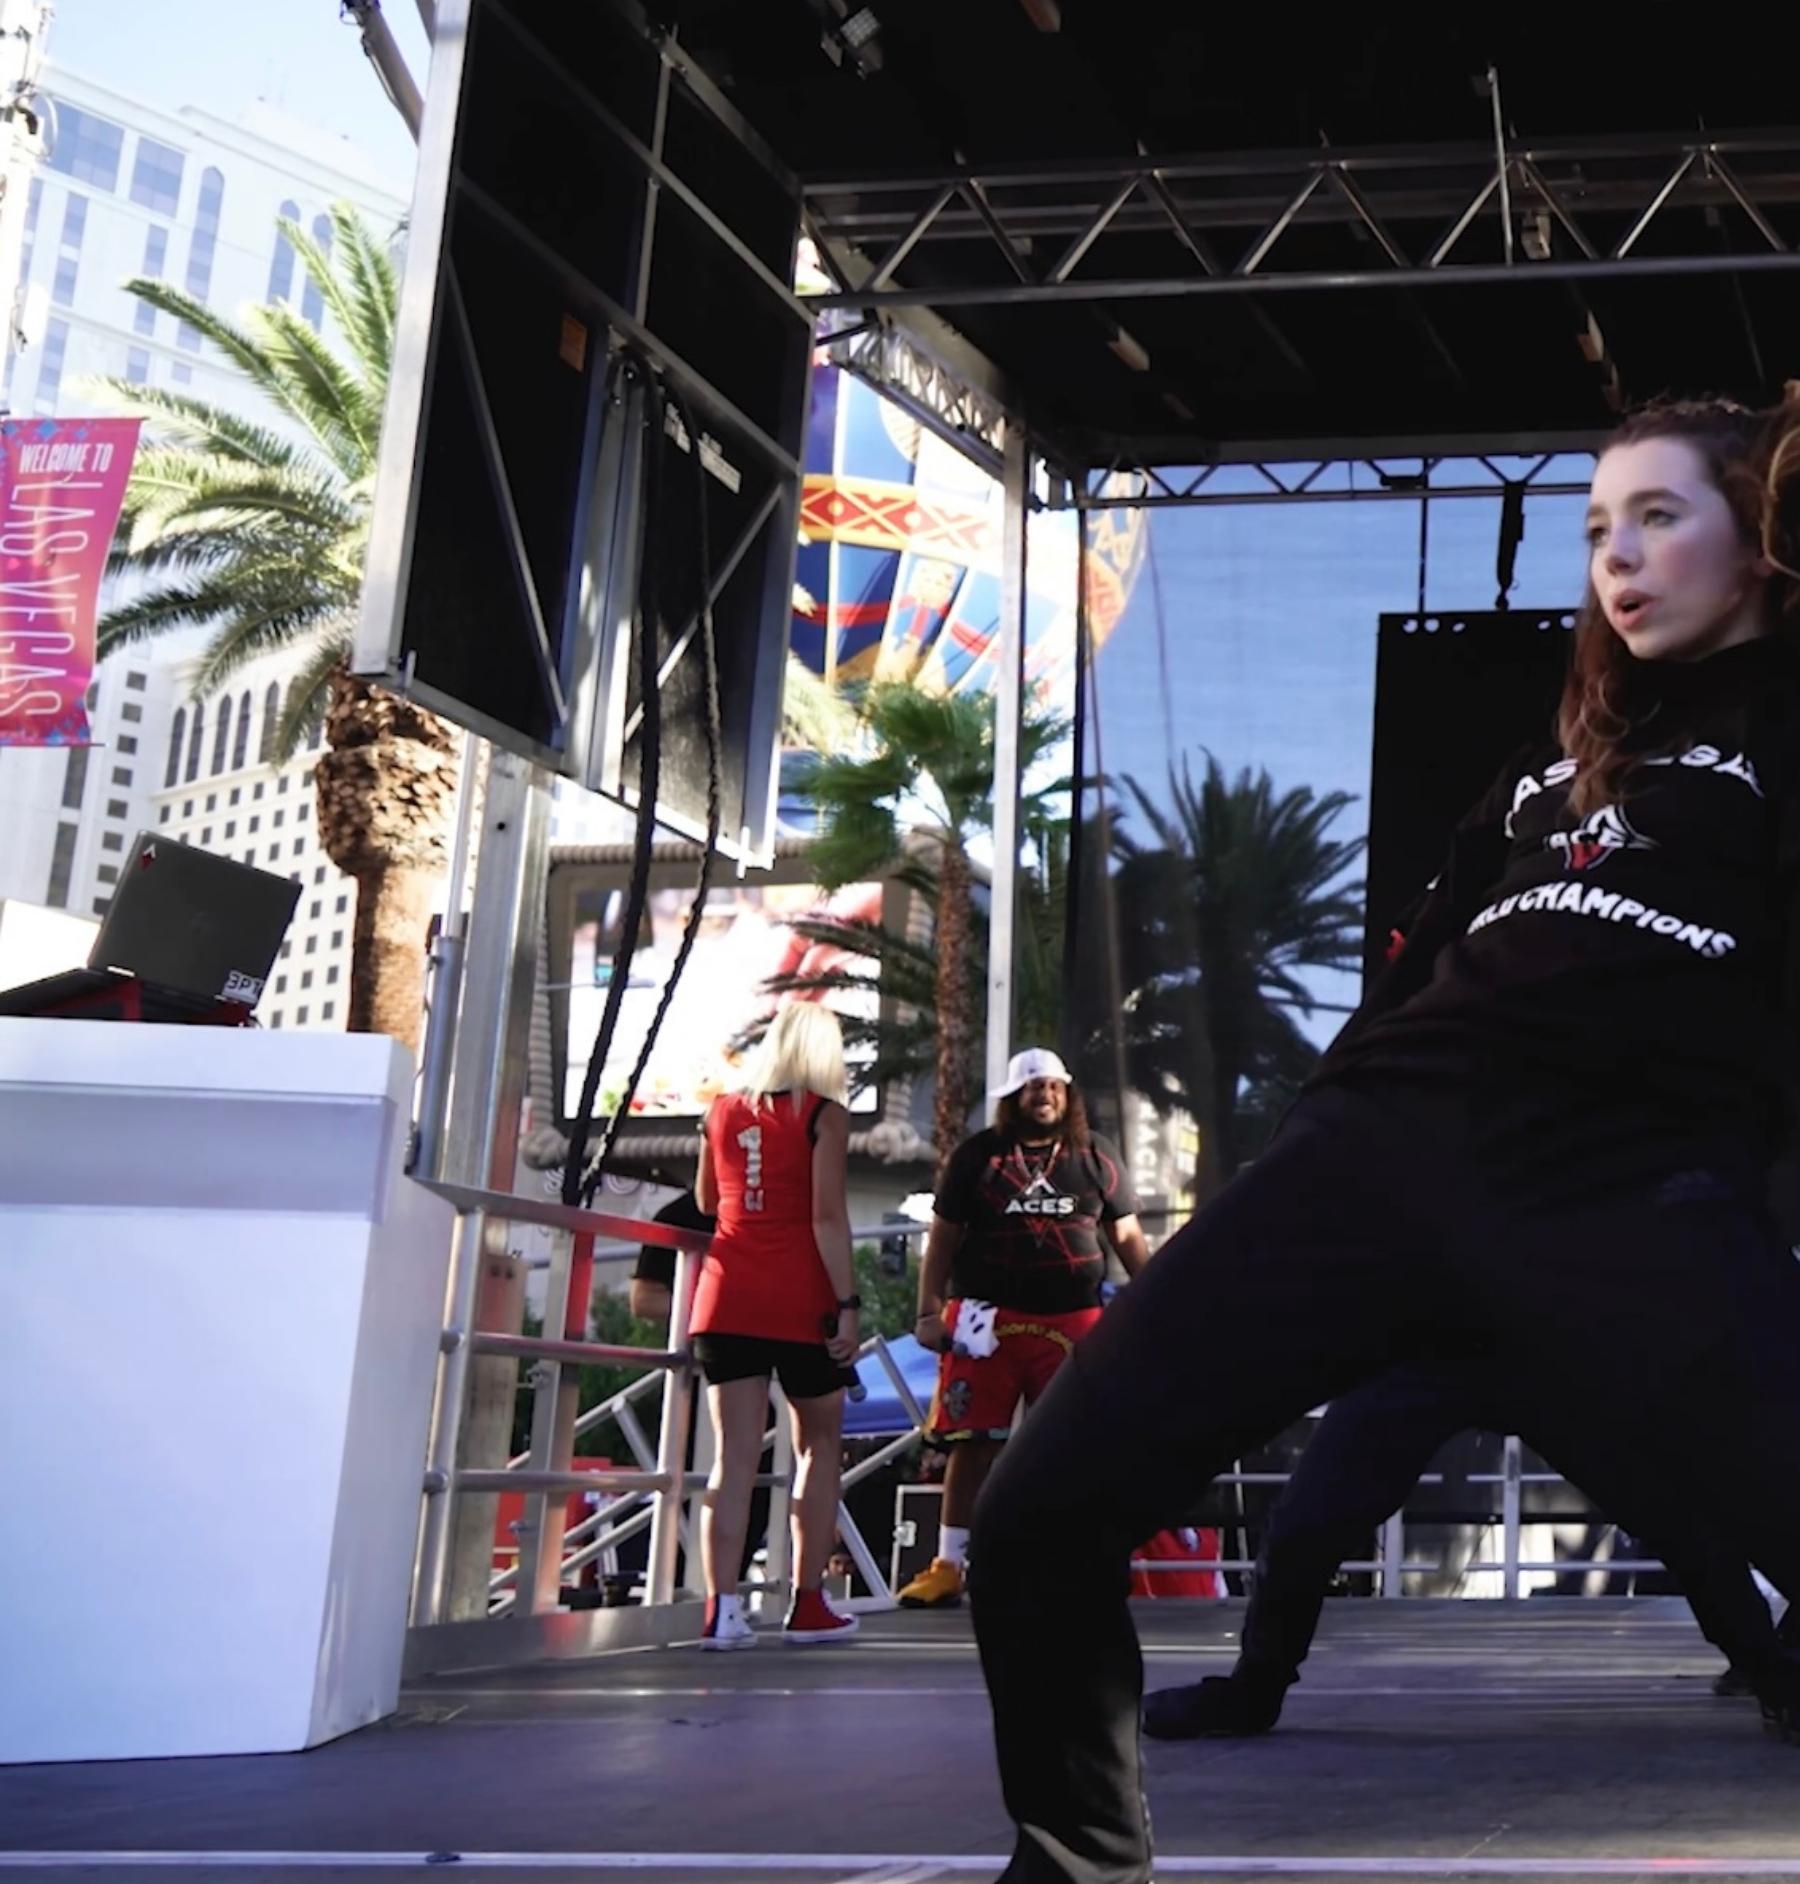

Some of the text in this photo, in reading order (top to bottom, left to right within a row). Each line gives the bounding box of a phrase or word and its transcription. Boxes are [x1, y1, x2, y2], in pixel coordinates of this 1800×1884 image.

[18, 443, 114, 473] WELCOME TO
[0, 481, 103, 556] LAS
[1518, 881, 1736, 959] CHAMPIONS
[1005, 1197, 1075, 1215] ACES
